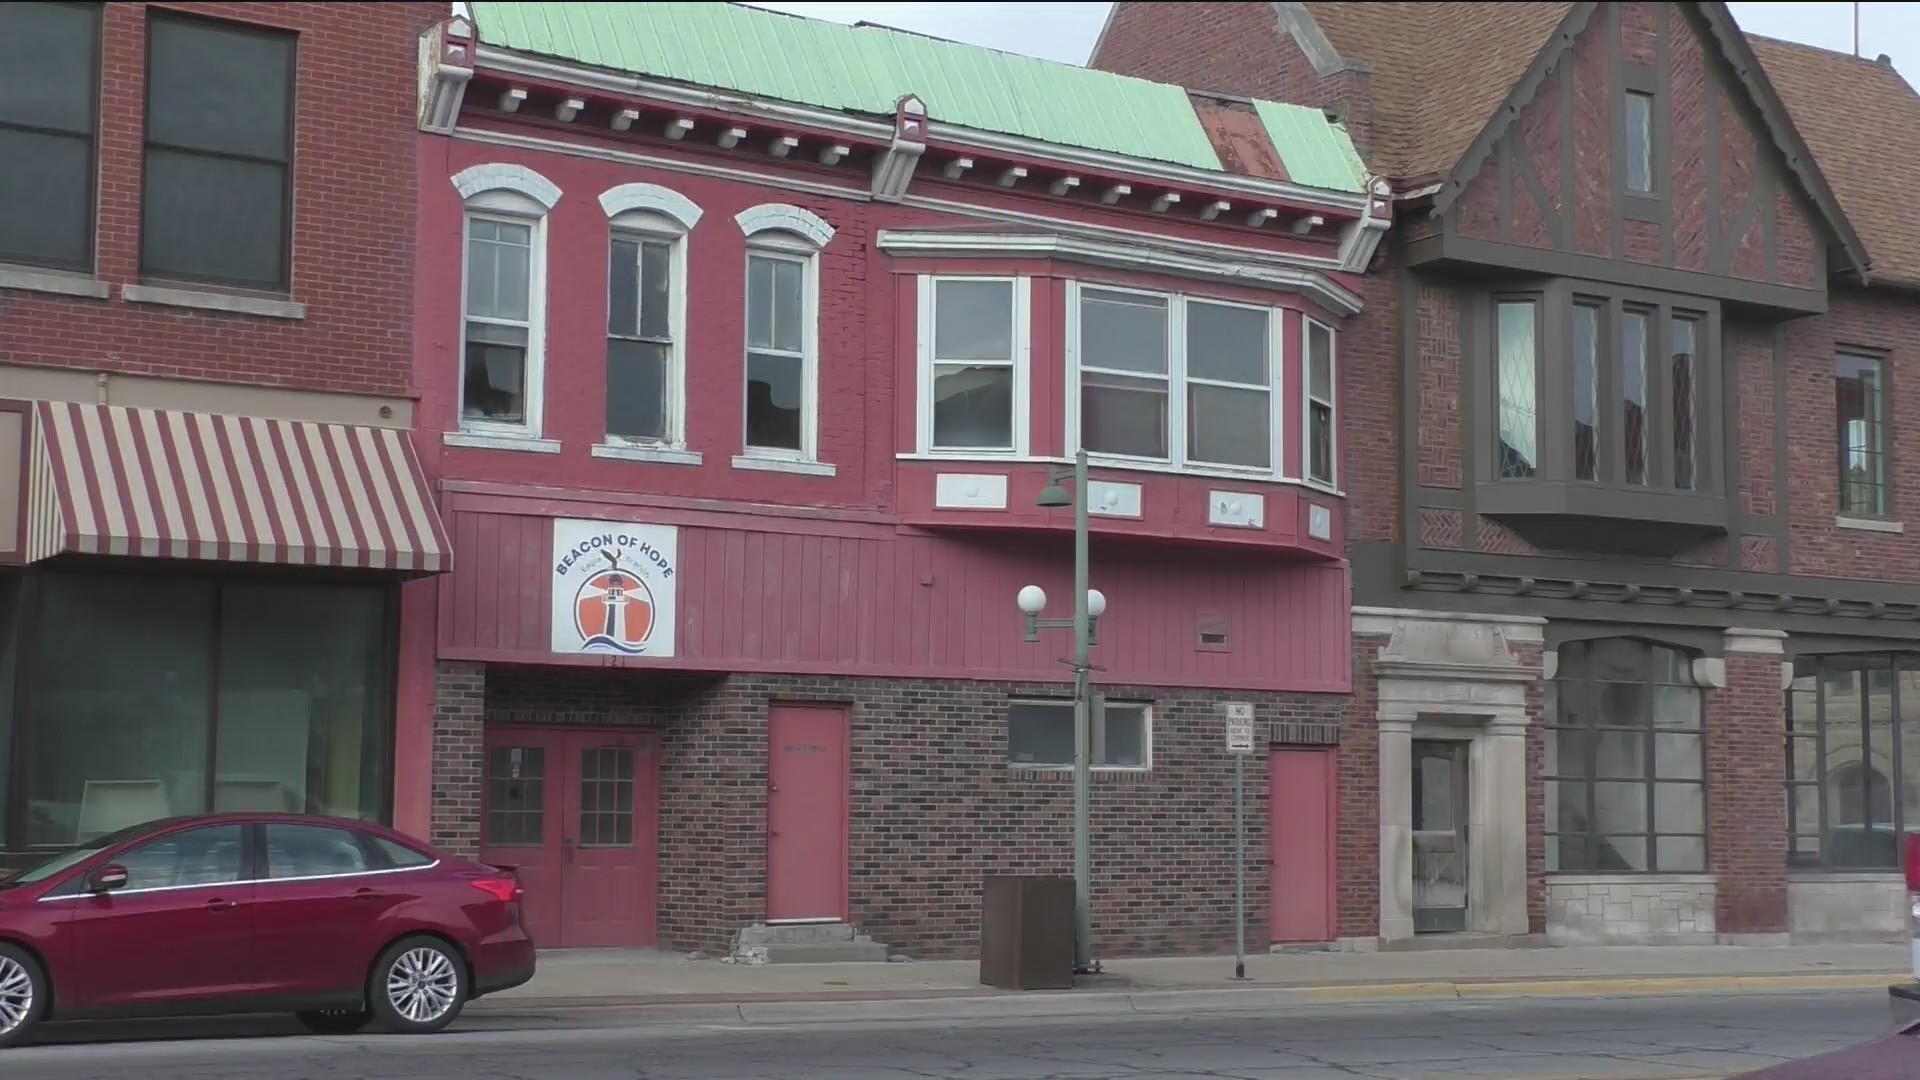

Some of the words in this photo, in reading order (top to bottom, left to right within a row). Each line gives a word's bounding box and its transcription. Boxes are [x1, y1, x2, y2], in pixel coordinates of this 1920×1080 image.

[556, 534, 613, 576] BEACON
[617, 534, 638, 548] OF
[639, 542, 674, 579] HOPE
